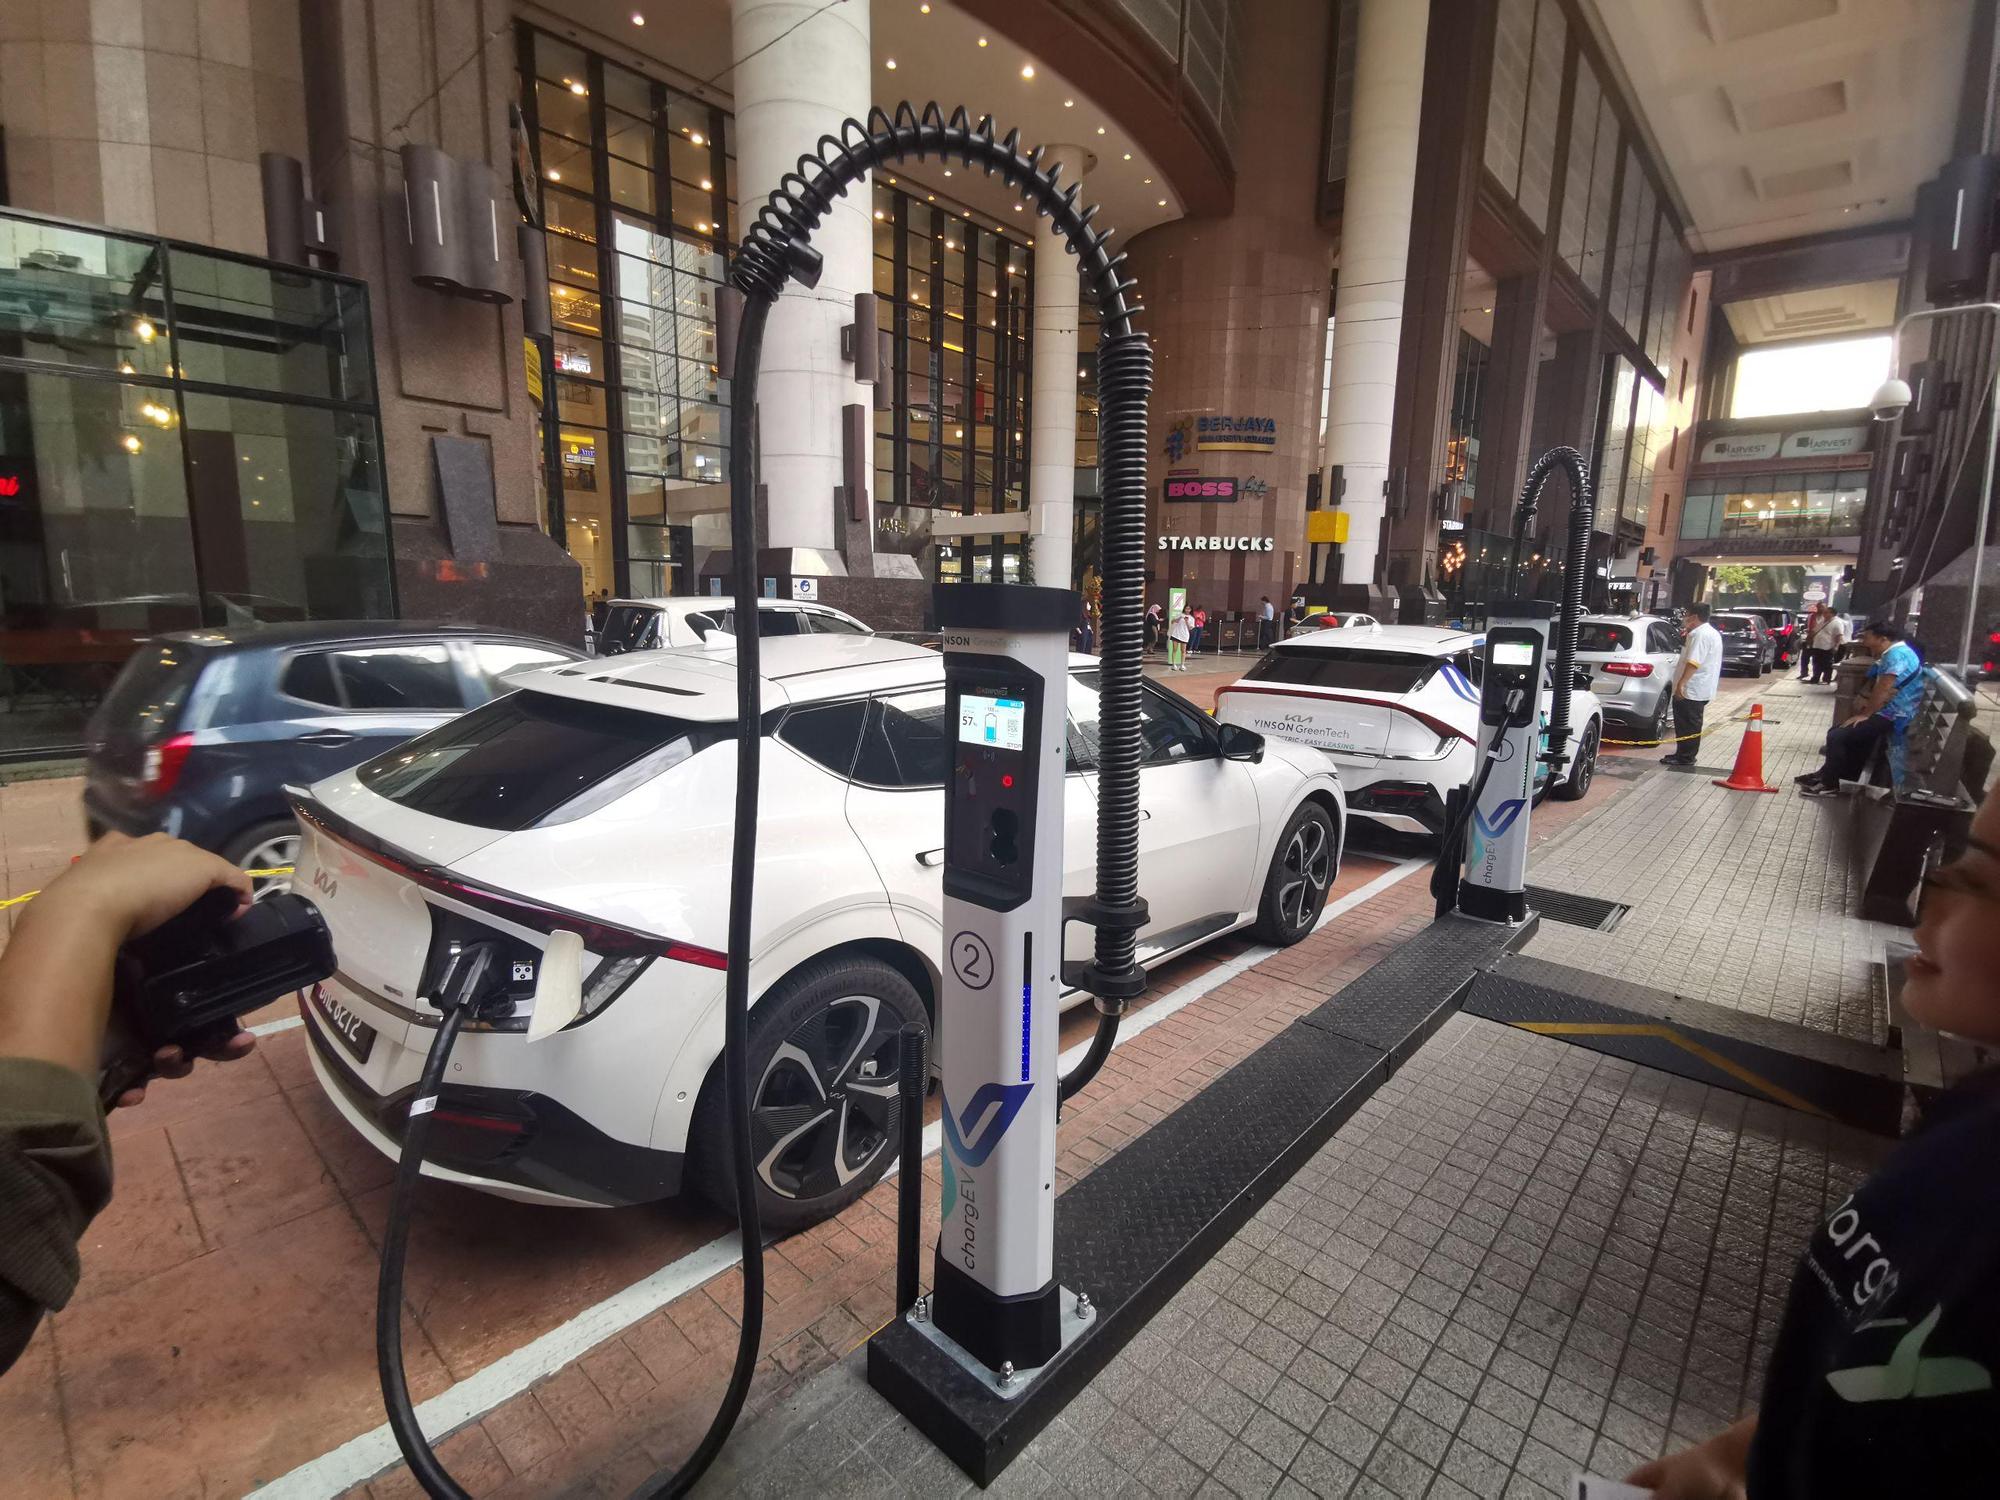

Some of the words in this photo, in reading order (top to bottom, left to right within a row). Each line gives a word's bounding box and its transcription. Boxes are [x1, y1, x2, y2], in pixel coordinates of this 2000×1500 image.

[1198, 416, 1276, 433] BERJAYA
[1168, 482, 1233, 497] BOSS
[1158, 536, 1274, 552] STARBUCKS
[962, 716, 973, 726] 57
[1254, 719, 1294, 732] YINSON
[1295, 724, 1350, 739] GreenTech
[1323, 741, 1355, 749] LEASING
[1483, 840, 1497, 884] chargEV
[962, 942, 981, 979] 2
[960, 1167, 980, 1271] chargEV
